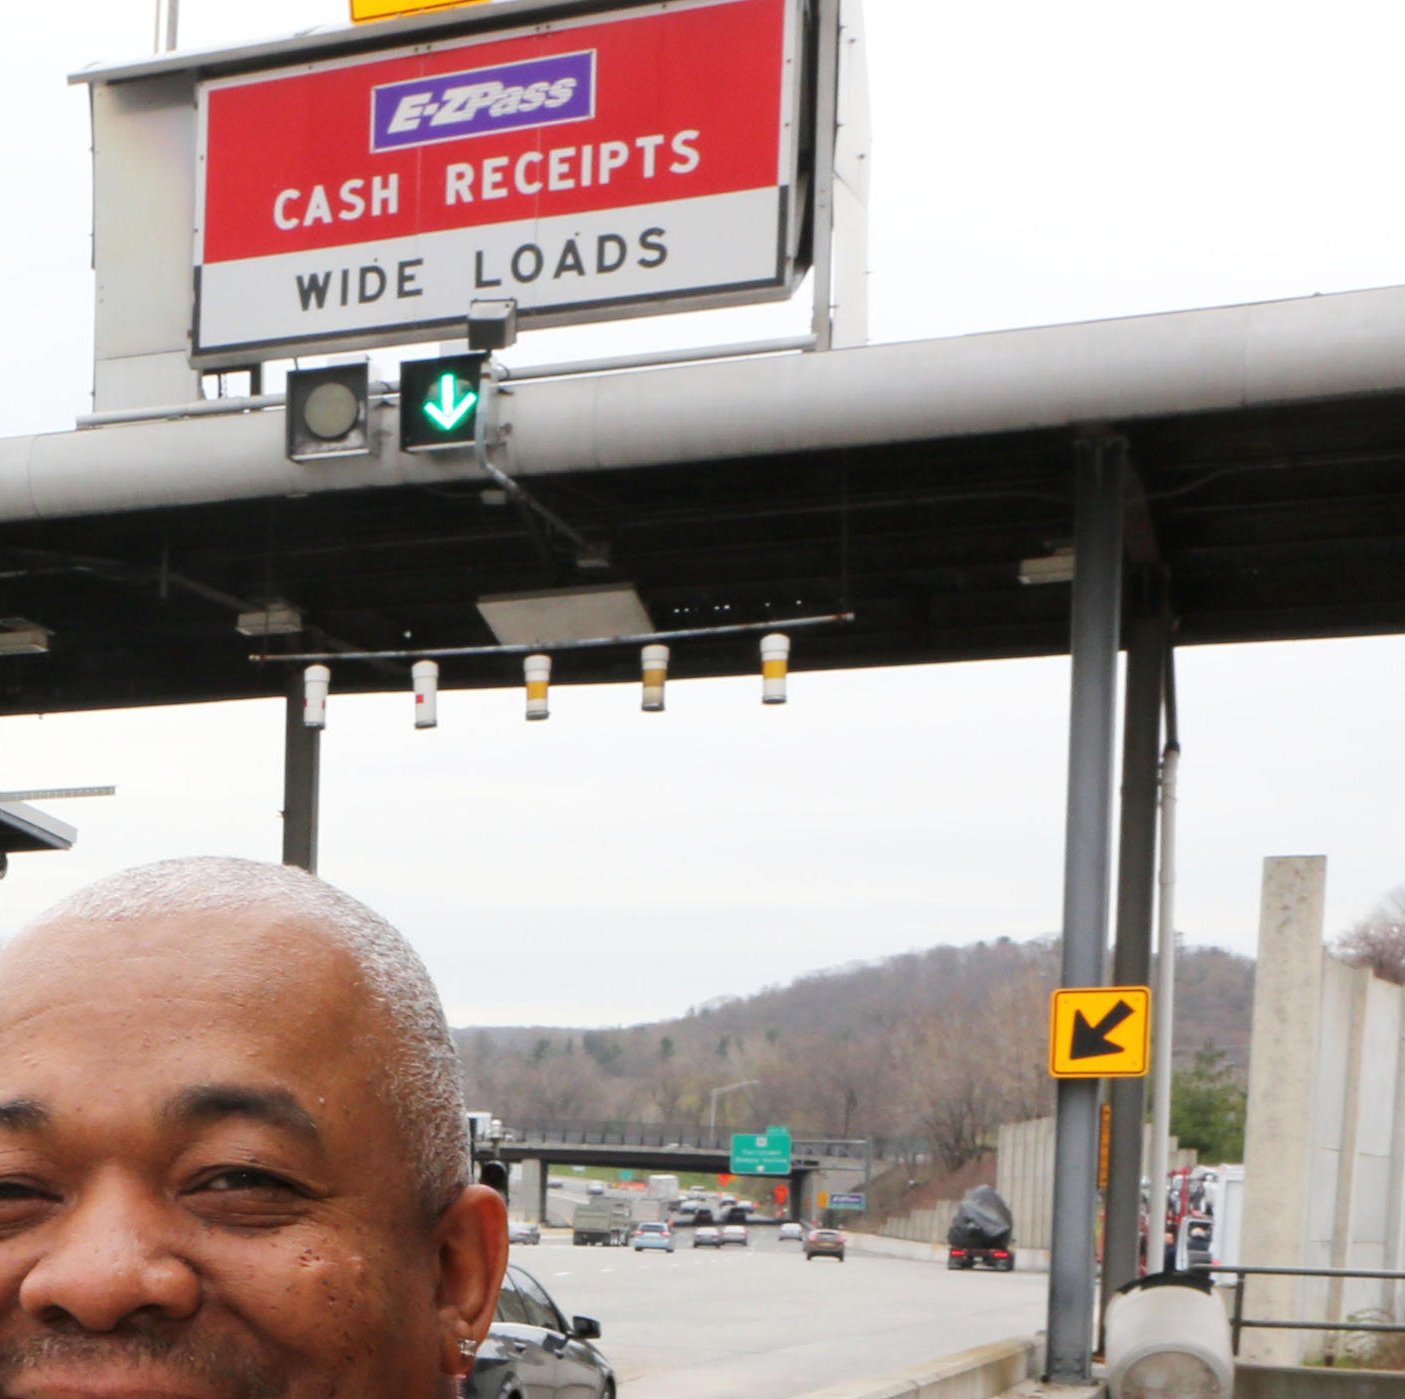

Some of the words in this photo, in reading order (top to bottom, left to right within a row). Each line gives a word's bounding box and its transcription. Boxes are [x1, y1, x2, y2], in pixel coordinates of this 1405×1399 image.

[387, 75, 577, 134] E-ZPass
[273, 173, 399, 230] CASH
[445, 129, 700, 205] RECEIPTS
[295, 258, 424, 313] WIDE
[474, 227, 669, 290] LOADS
